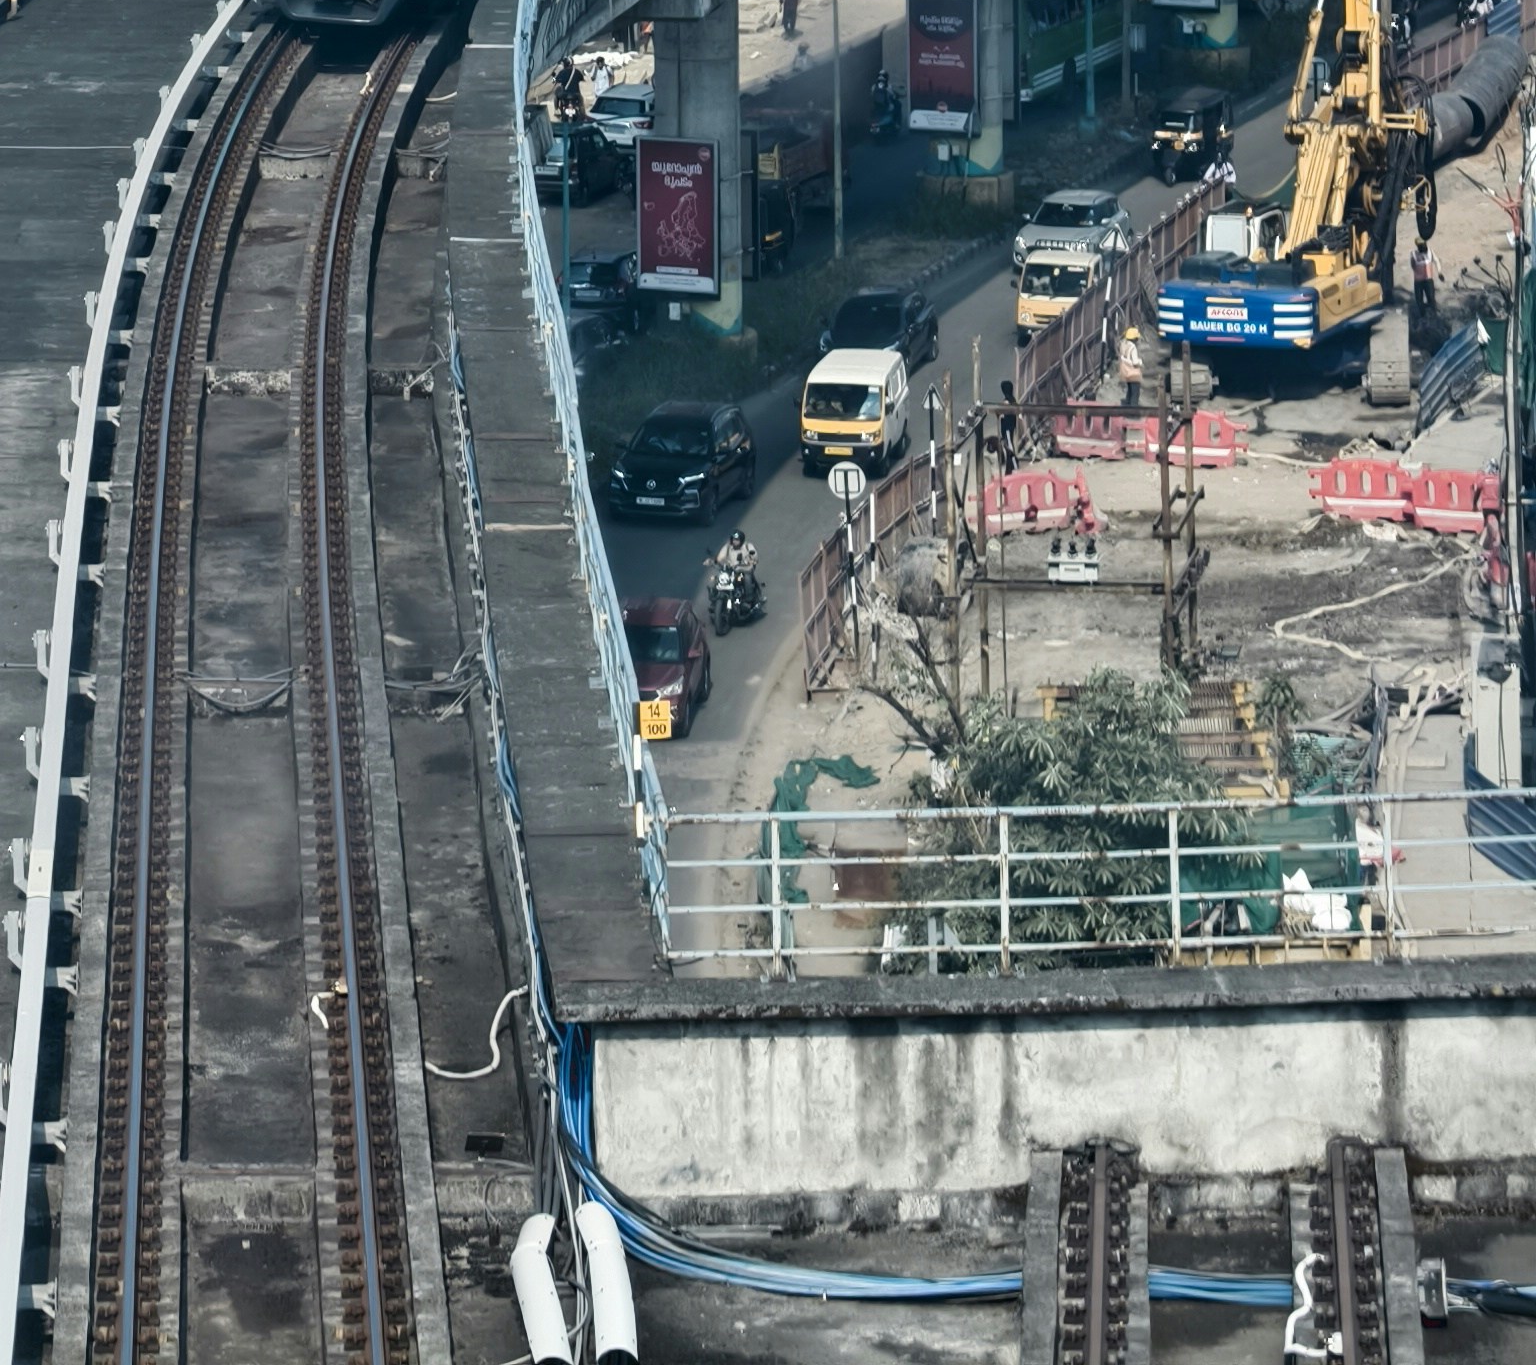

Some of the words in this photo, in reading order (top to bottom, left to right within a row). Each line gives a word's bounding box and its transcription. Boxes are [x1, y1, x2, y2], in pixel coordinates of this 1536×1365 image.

[1189, 320, 1224, 332] BAUER
[1226, 322, 1241, 333] BG
[1244, 323, 1257, 334] 20
[1259, 324, 1268, 335] H
[648, 703, 661, 718] 14
[646, 723, 667, 735] 100
